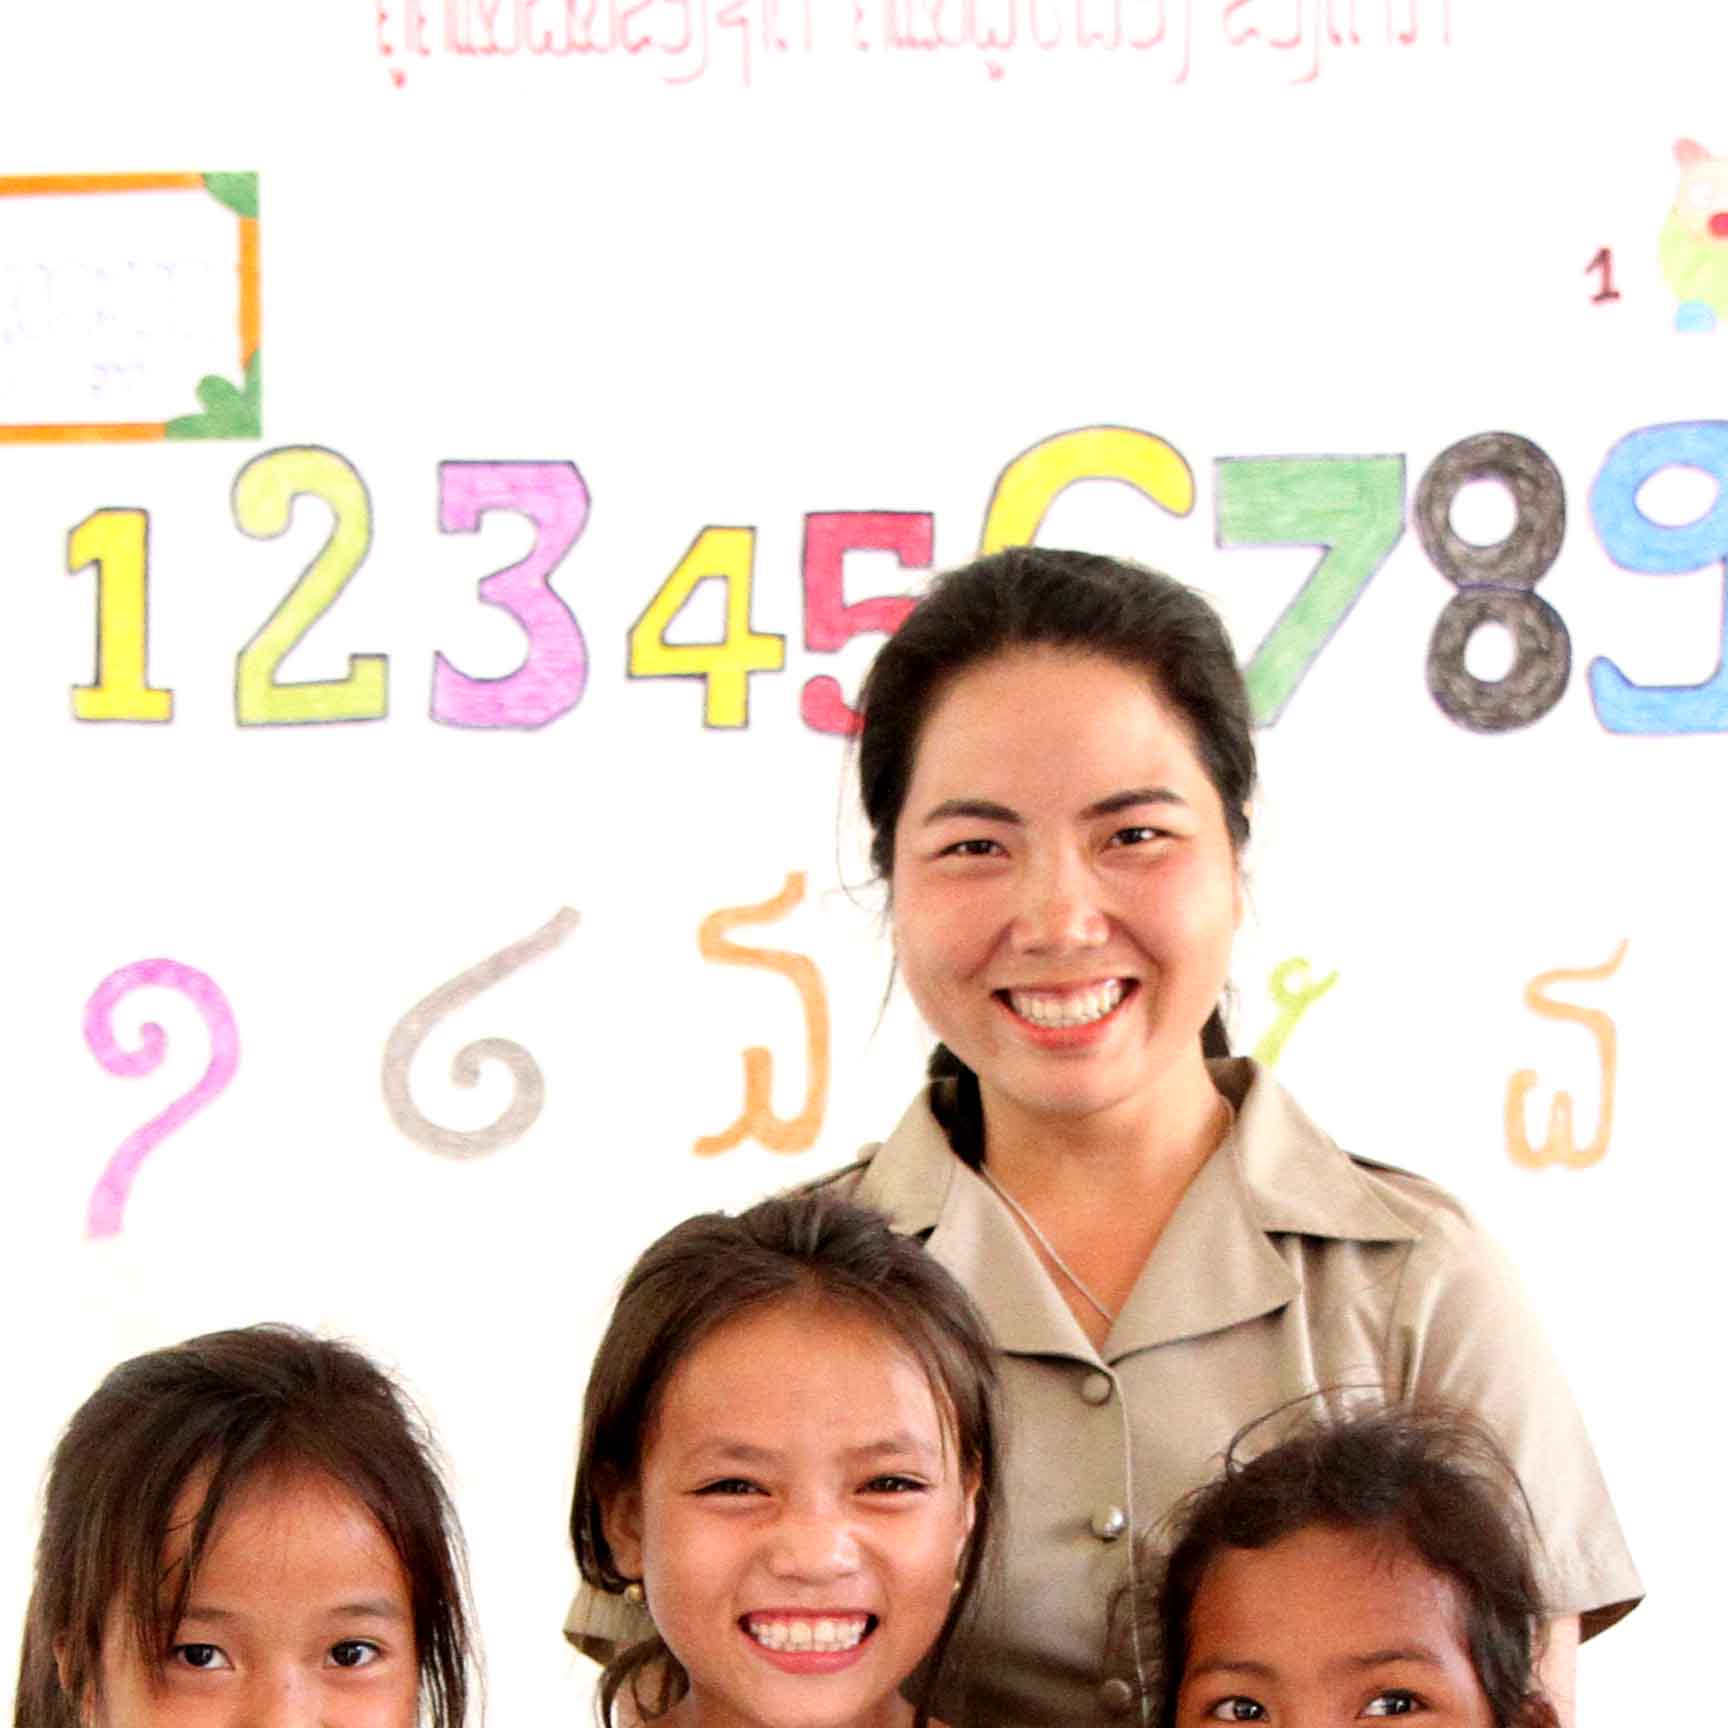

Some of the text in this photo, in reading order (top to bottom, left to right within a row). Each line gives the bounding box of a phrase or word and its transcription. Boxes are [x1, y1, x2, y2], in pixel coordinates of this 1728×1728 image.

[1585, 246, 1622, 305] 1
[62, 504, 176, 727] 1
[228, 443, 391, 729] 2
[427, 458, 592, 731] 3
[624, 523, 788, 732] 4
[801, 510, 934, 737] 5
[1214, 453, 1407, 730] 7
[1414, 429, 1574, 736] 8
